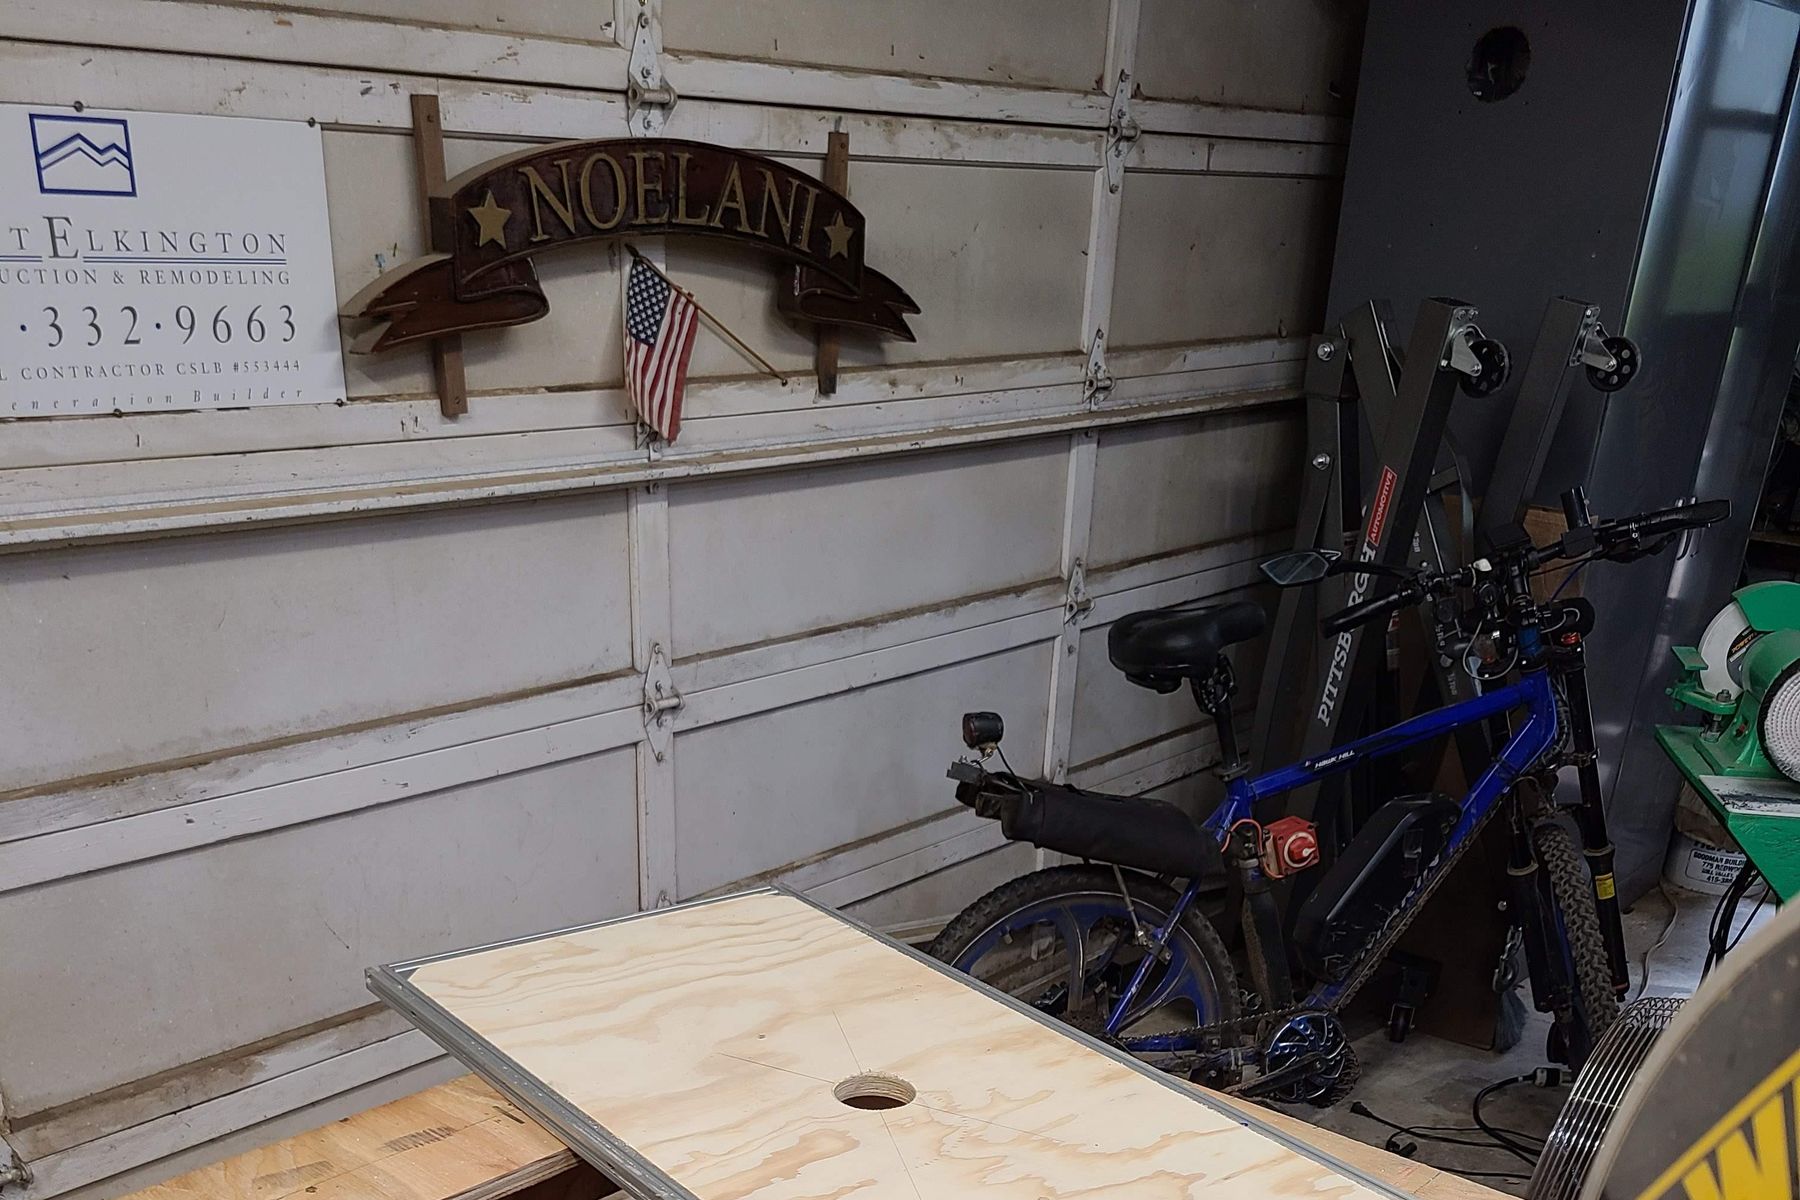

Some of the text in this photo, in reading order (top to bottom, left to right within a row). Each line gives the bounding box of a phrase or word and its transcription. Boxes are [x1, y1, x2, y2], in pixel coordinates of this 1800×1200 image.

[517, 151, 822, 254] NOELANI
[42, 215, 287, 259] ELKINGTON
[113, 269, 125, 285] &
[139, 269, 290, 286] REMODELING
[21, 362, 165, 380] CONTRACTOR
[176, 361, 222, 375] CSLB
[233, 359, 300, 373] #553444
[193, 387, 303, 403] Builder
[1369, 470, 1394, 542] AUTOMOTIVE
[1317, 540, 1376, 727] PITTSBRGH
